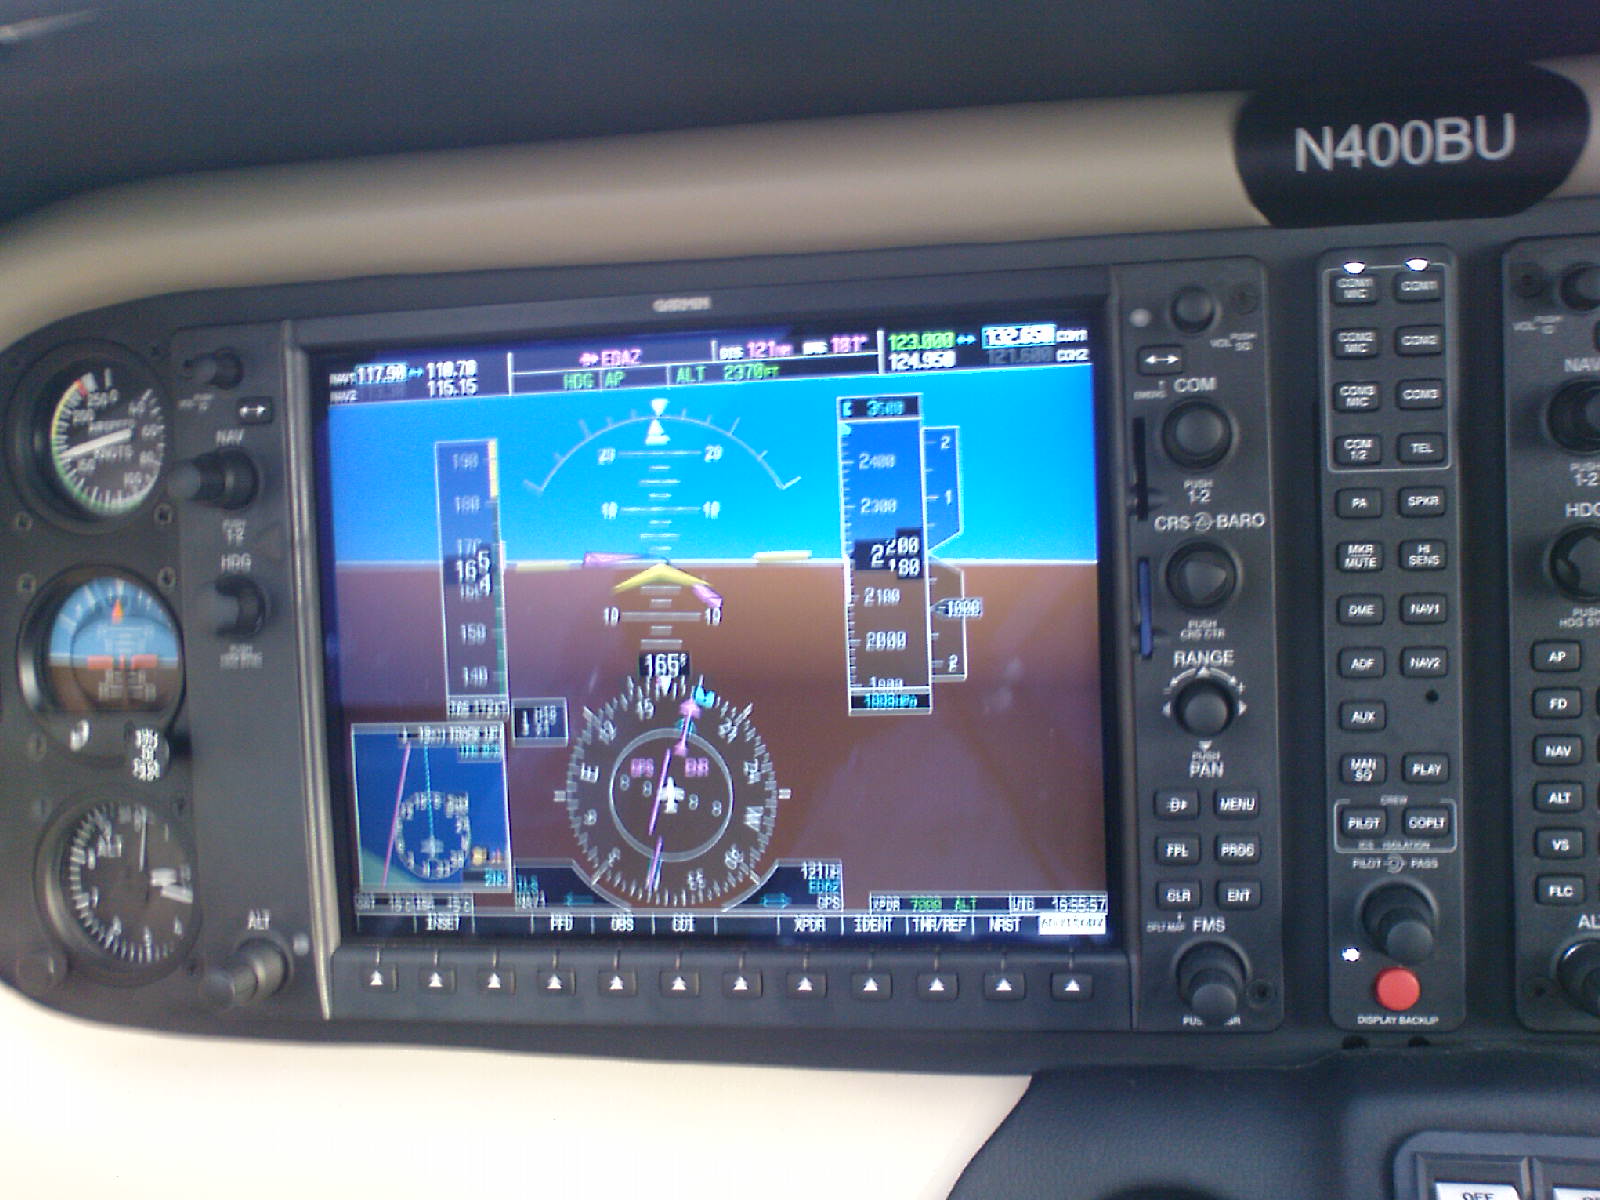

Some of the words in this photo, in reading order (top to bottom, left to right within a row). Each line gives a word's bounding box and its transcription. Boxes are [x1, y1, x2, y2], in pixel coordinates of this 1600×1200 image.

[1295, 113, 1515, 172] N400BU
[605, 371, 624, 388] AP
[676, 366, 706, 384] ALT
[1173, 377, 1217, 392] COM
[941, 436, 950, 449] 2
[1410, 443, 1434, 454] TEL
[945, 490, 952, 504] 1
[1188, 489, 1212, 503] 1-2
[1408, 496, 1439, 507] SPKR
[1352, 498, 1367, 509] PA
[1154, 515, 1191, 531] CRS
[1216, 512, 1265, 529] BARO
[1348, 544, 1374, 555] MKR
[1418, 544, 1431, 554] HI
[1345, 556, 1377, 569] MUTE
[1408, 555, 1440, 566] SENS
[1411, 603, 1440, 615] NAV1
[1173, 650, 1235, 667] RANGE
[1549, 651, 1566, 662] AP
[1351, 658, 1375, 670] ADF
[1410, 657, 1440, 669] NAV2
[1549, 698, 1567, 710] FD
[1351, 711, 1376, 723] AUX
[1545, 745, 1572, 756] NAV
[1189, 762, 1224, 778] PAN
[1412, 763, 1442, 776] PLAY
[1549, 792, 1571, 804] ALT
[1220, 798, 1255, 811] MENU
[1348, 817, 1381, 829] PILOT
[1408, 817, 1445, 829] COPLT
[1166, 844, 1188, 858] FPL
[1221, 844, 1254, 857] PROG
[1552, 839, 1569, 851] VS
[1352, 858, 1381, 869] PILOT
[1167, 889, 1191, 902] CLR
[1227, 889, 1251, 902] ENT
[1549, 885, 1573, 897] FLC
[953, 896, 976, 912] ALT
[853, 917, 893, 932] IDENT
[912, 917, 967, 932] TMR/REF
[988, 917, 1021, 932] NRST
[1192, 916, 1225, 933] FMS
[1578, 913, 1600, 929] AL
[1357, 1015, 1397, 1025] DISPLAY
[1398, 1015, 1439, 1025] BACKUP
